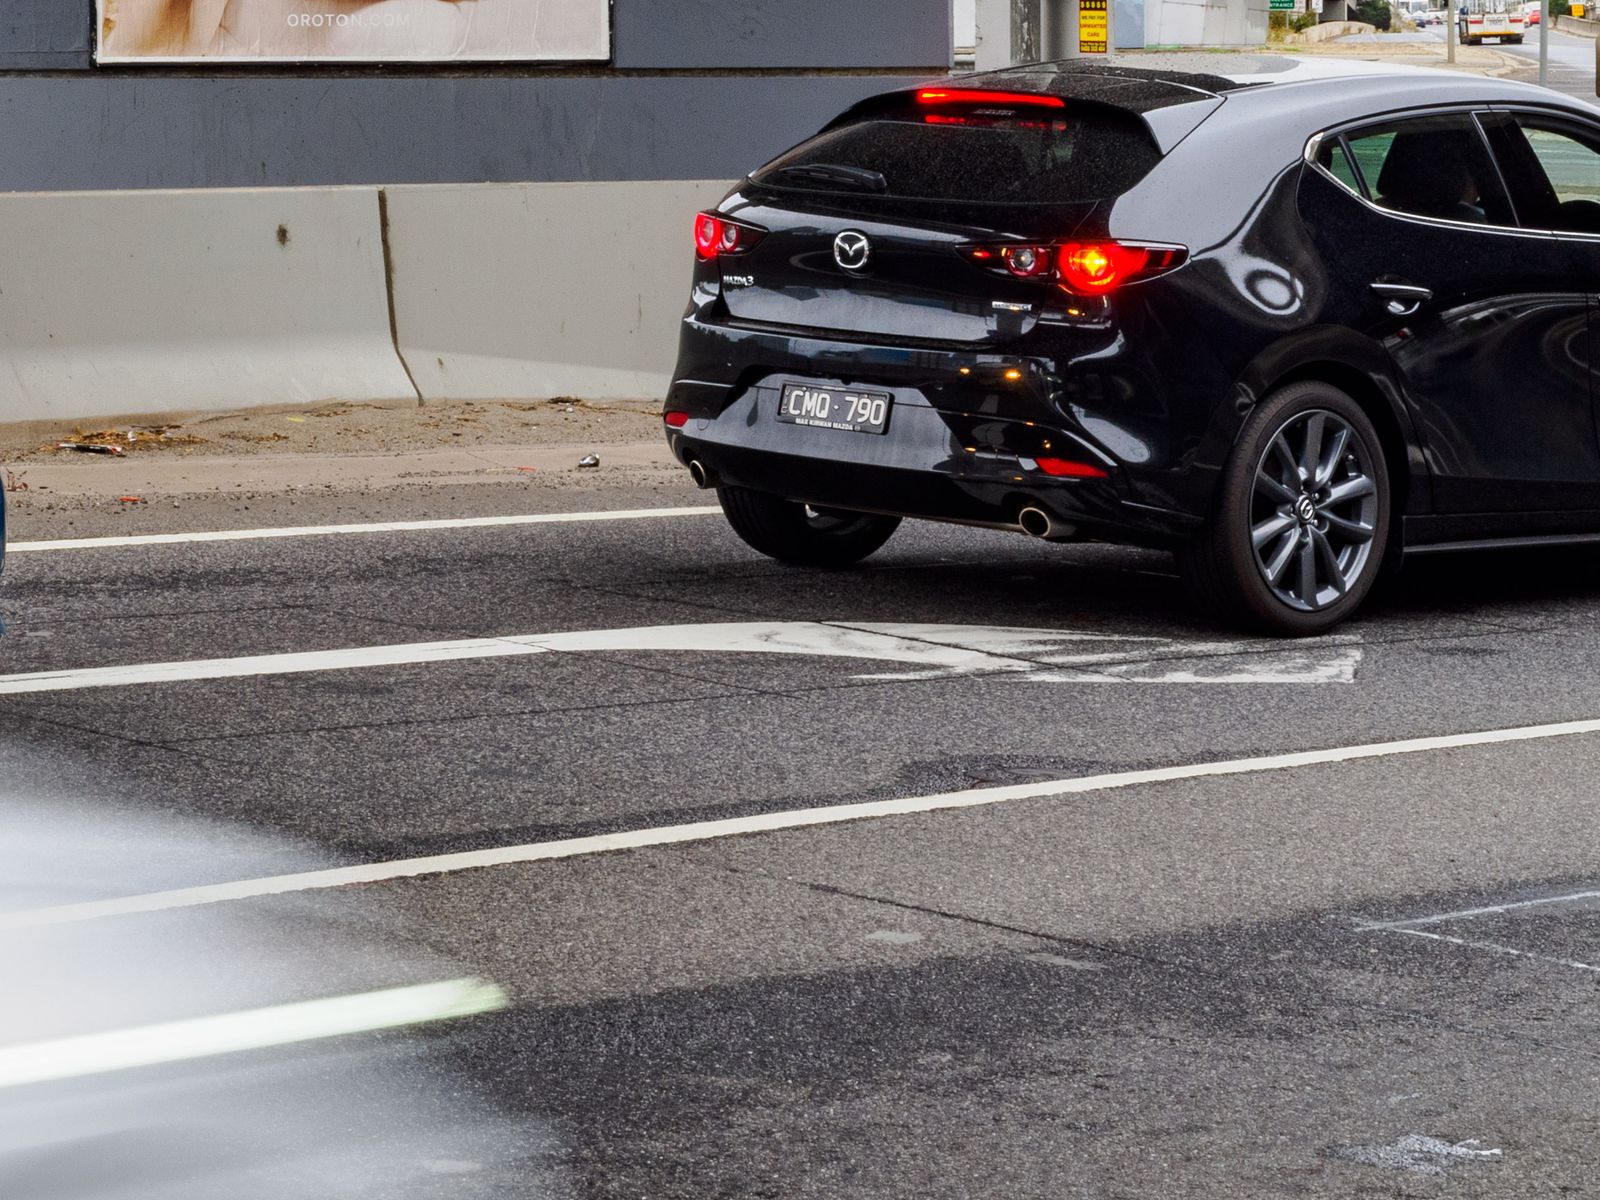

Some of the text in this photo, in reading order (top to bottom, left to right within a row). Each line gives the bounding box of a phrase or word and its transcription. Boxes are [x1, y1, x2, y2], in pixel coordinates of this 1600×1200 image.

[287, 12, 410, 27] OROTON.COM
[788, 390, 886, 426] CMQ 790
